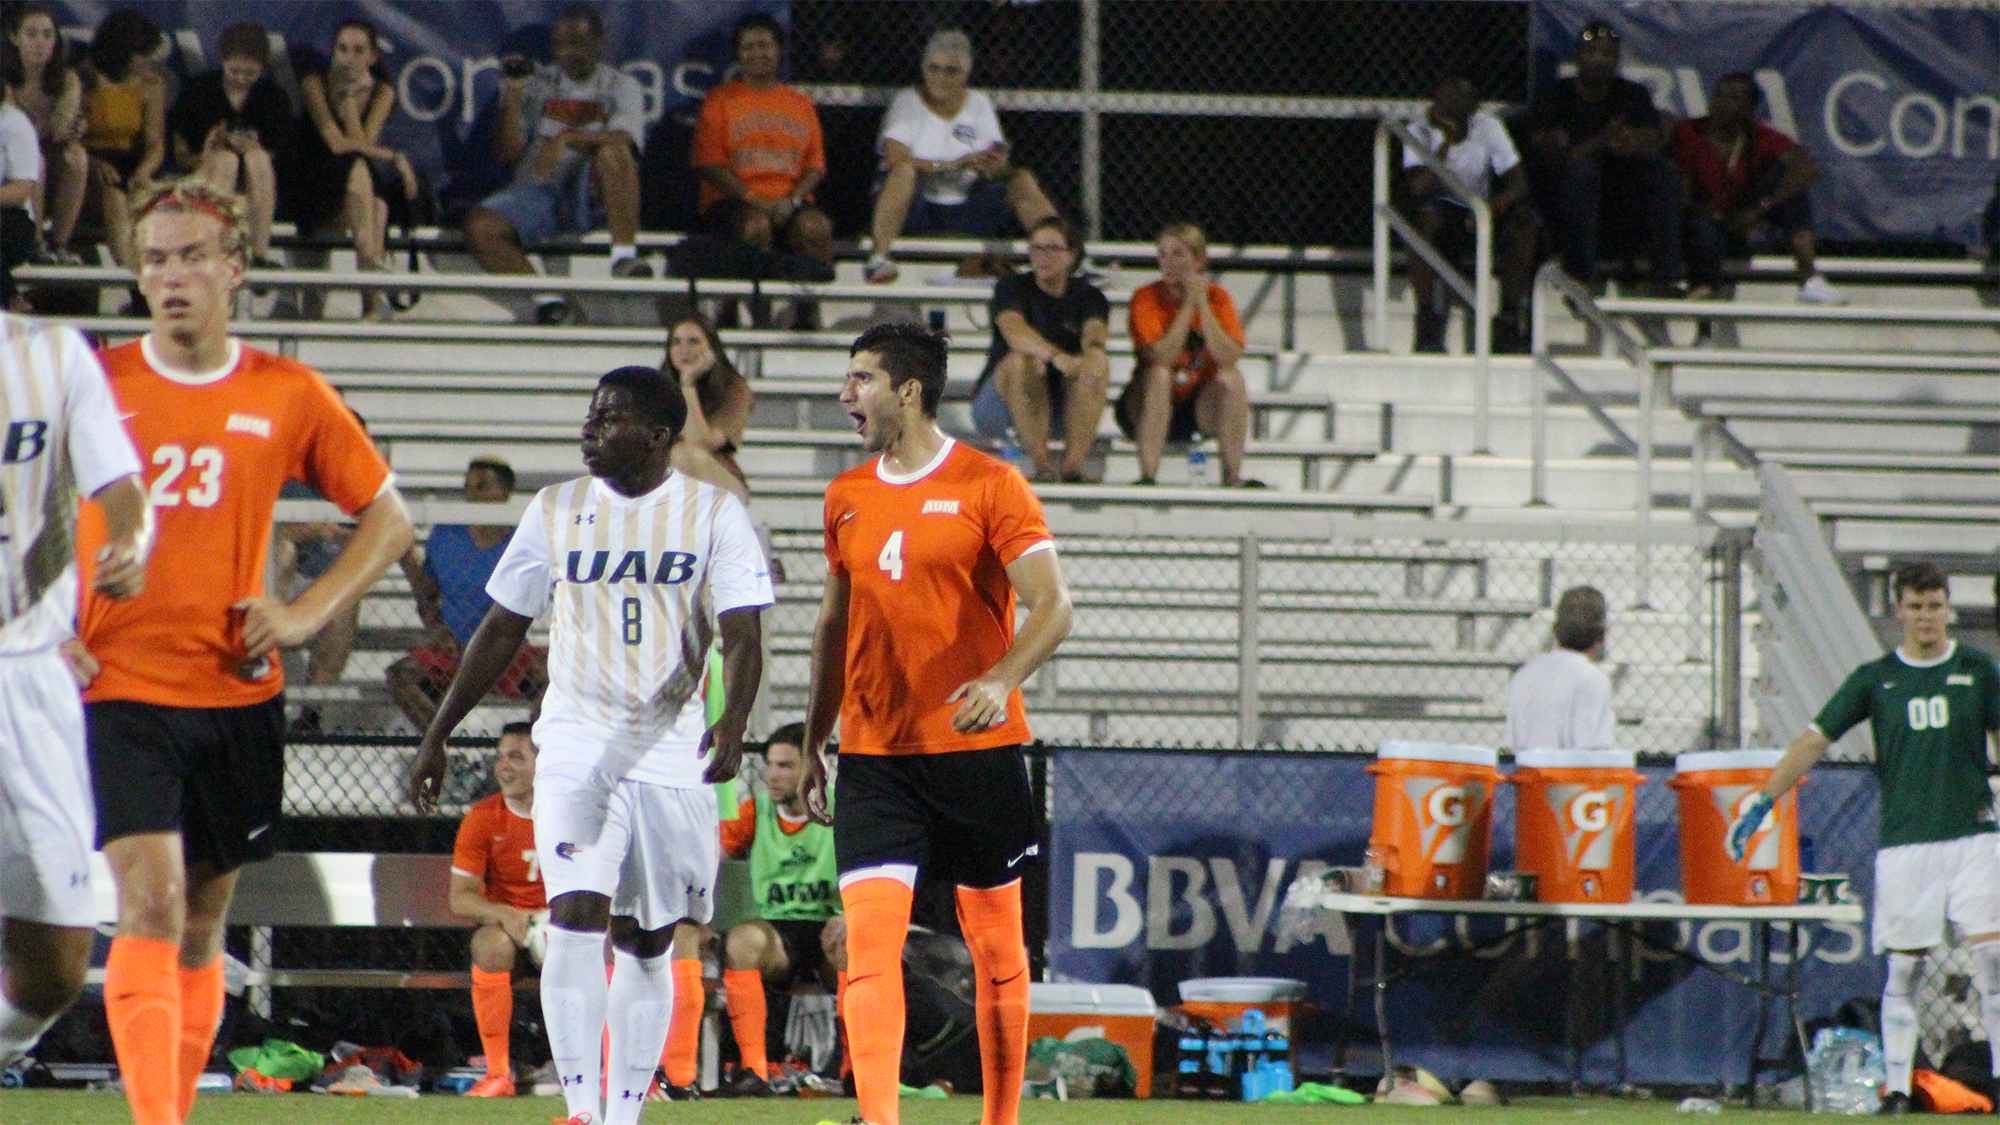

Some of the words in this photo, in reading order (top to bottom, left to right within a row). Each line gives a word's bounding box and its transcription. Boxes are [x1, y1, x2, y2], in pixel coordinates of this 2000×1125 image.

[151, 445, 223, 507] 23
[921, 500, 960, 515] AUM
[566, 550, 697, 584] UAB
[878, 531, 903, 580] 4
[622, 598, 642, 646] 8
[1907, 696, 1949, 730] 00
[1429, 786, 1465, 826] G
[1571, 791, 1608, 831] G
